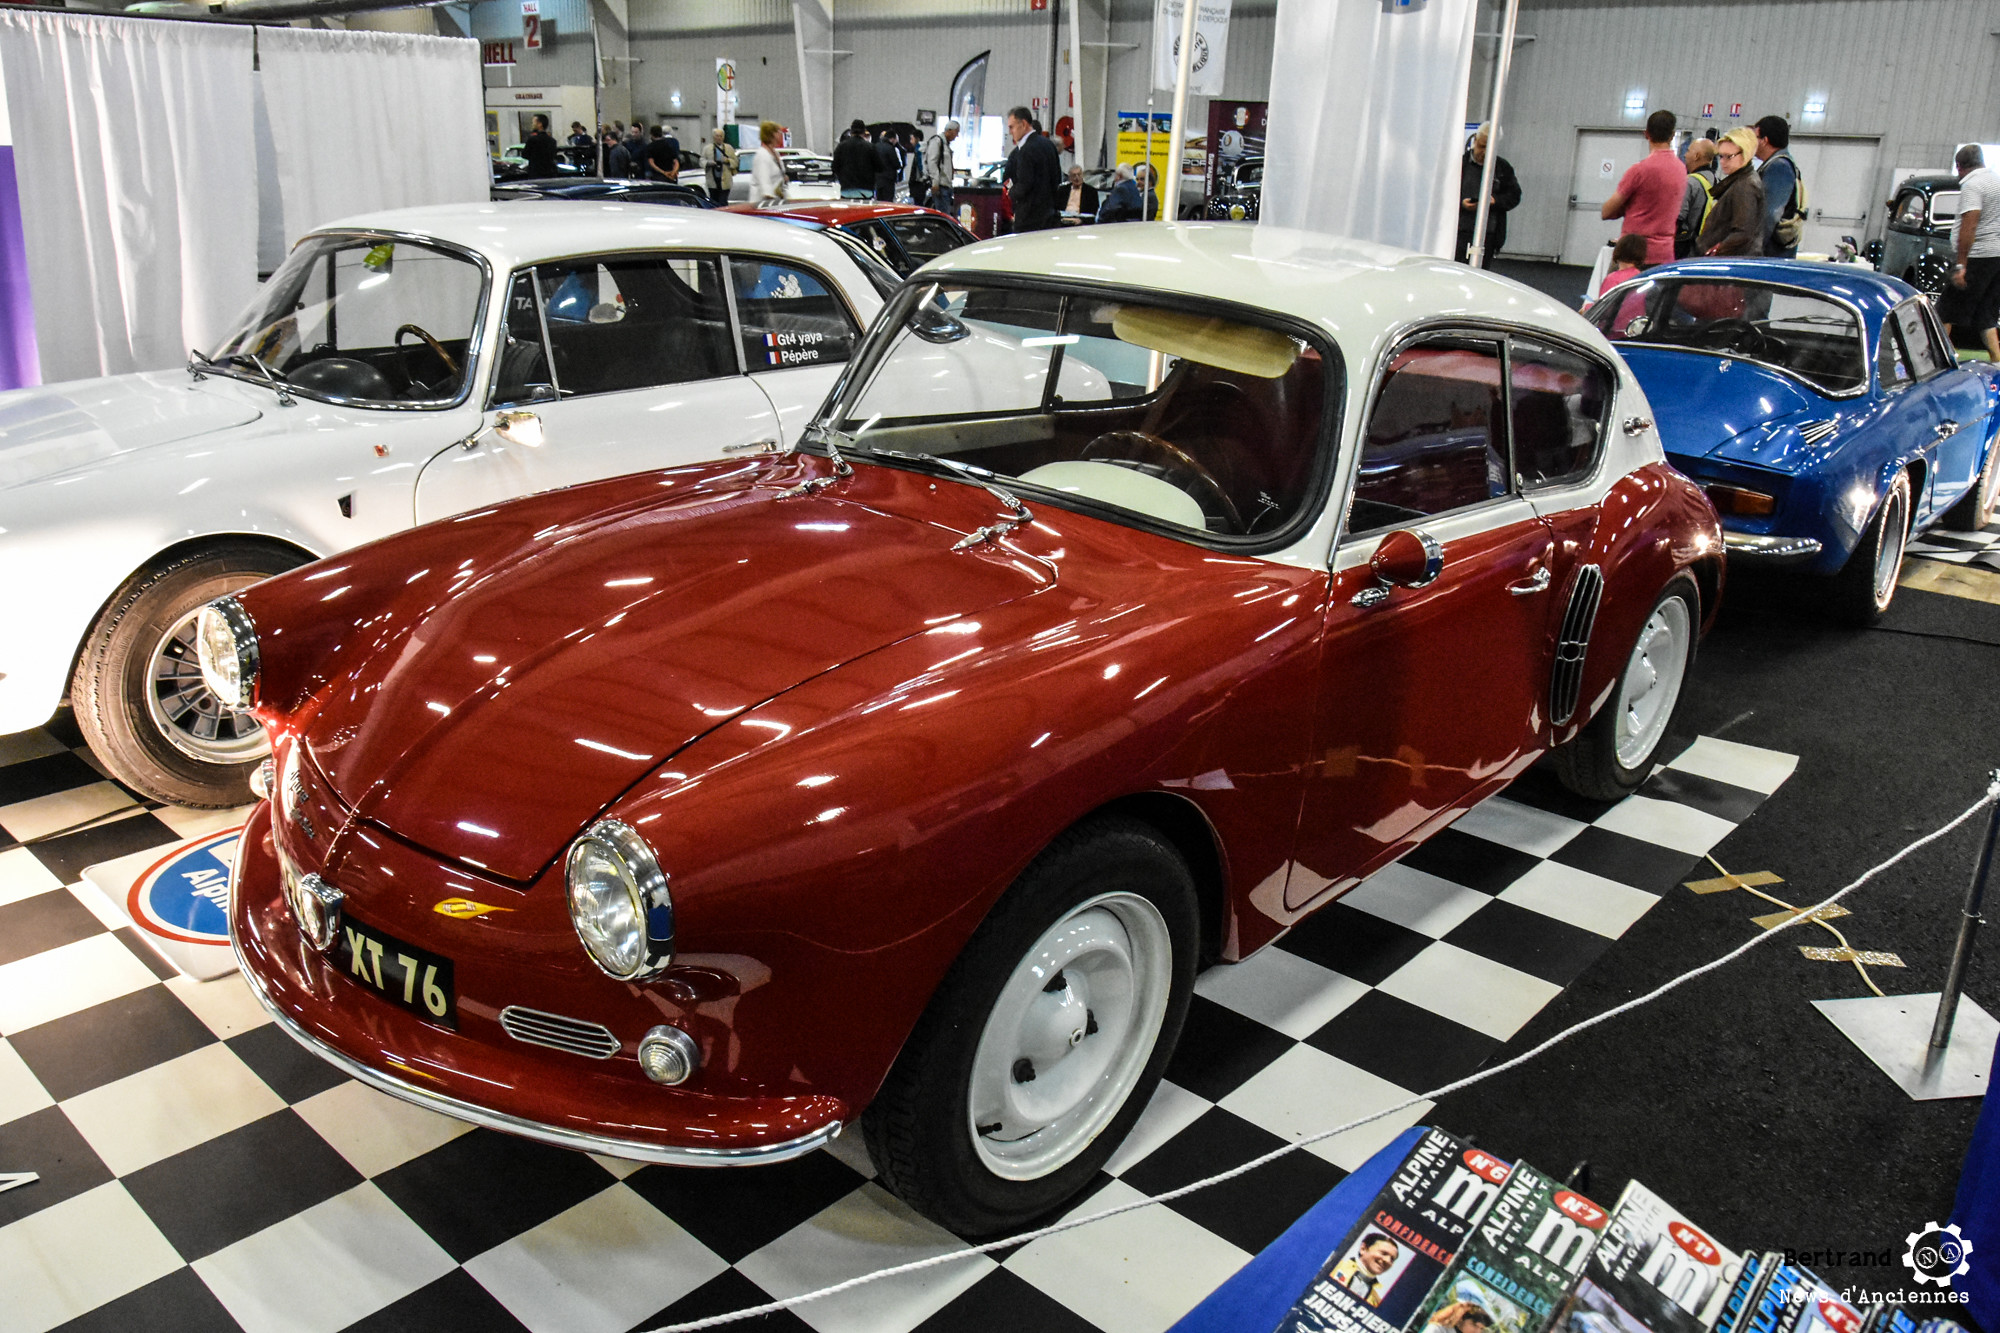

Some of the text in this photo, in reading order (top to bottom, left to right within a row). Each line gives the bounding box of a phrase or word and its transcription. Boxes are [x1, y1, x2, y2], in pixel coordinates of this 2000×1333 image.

[523, 3, 537, 12] HALL
[525, 15, 540, 48] 2
[484, 42, 517, 63] HELL
[777, 332, 823, 346] Gt4 yaya
[781, 348, 819, 364] Pépère
[345, 925, 447, 1017] XT 76
[1391, 1130, 1450, 1203] ALPINE
[1406, 1141, 1458, 1209] RENAULT
[1432, 1164, 1500, 1226] m
[1480, 1168, 1538, 1247] ALPINE
[1498, 1180, 1549, 1254] RENAULT
[1421, 1209, 1465, 1234] ALP
[1524, 1207, 1597, 1276] m
[1514, 1255, 1570, 1291] ALPI
